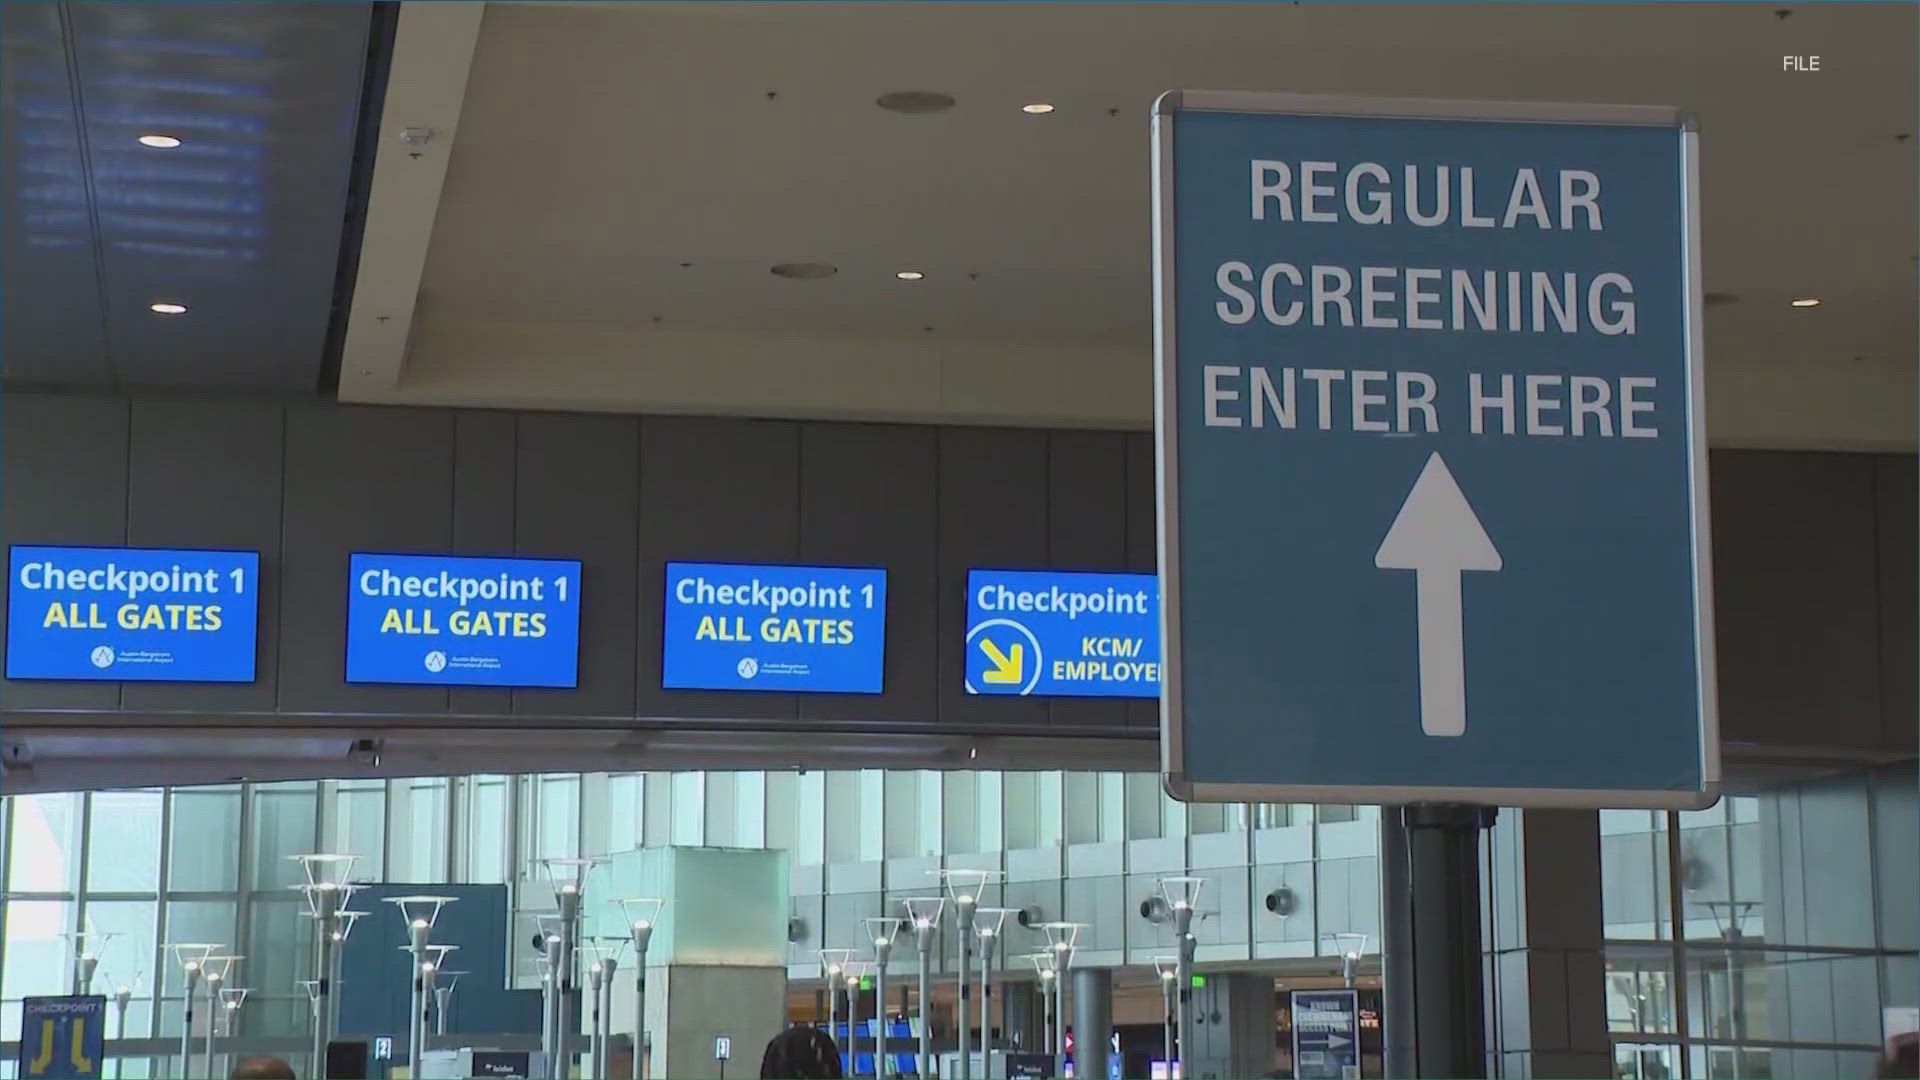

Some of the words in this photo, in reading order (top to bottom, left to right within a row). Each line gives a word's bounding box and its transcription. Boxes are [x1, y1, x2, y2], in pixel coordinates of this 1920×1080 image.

[1251, 159, 1603, 231] REGULAR
[1216, 260, 1636, 335] SCREENING
[1203, 365, 1439, 432] ENTER
[1470, 373, 1658, 438] HERE
[20, 562, 218, 595] Checkpoint
[230, 568, 243, 593] 1
[360, 569, 544, 605] Checkpoint
[554, 576, 567, 601] 1
[676, 577, 851, 613] Checkpoint
[861, 584, 873, 609] 1
[43, 602, 107, 629] ALL
[116, 603, 222, 631] GATES
[977, 584, 1148, 620] Checkpoint
[380, 608, 440, 635] ALL
[448, 610, 547, 638] GATES
[695, 615, 752, 642] ALL
[760, 617, 854, 645] GATES
[1082, 637, 1143, 658] KCM/
